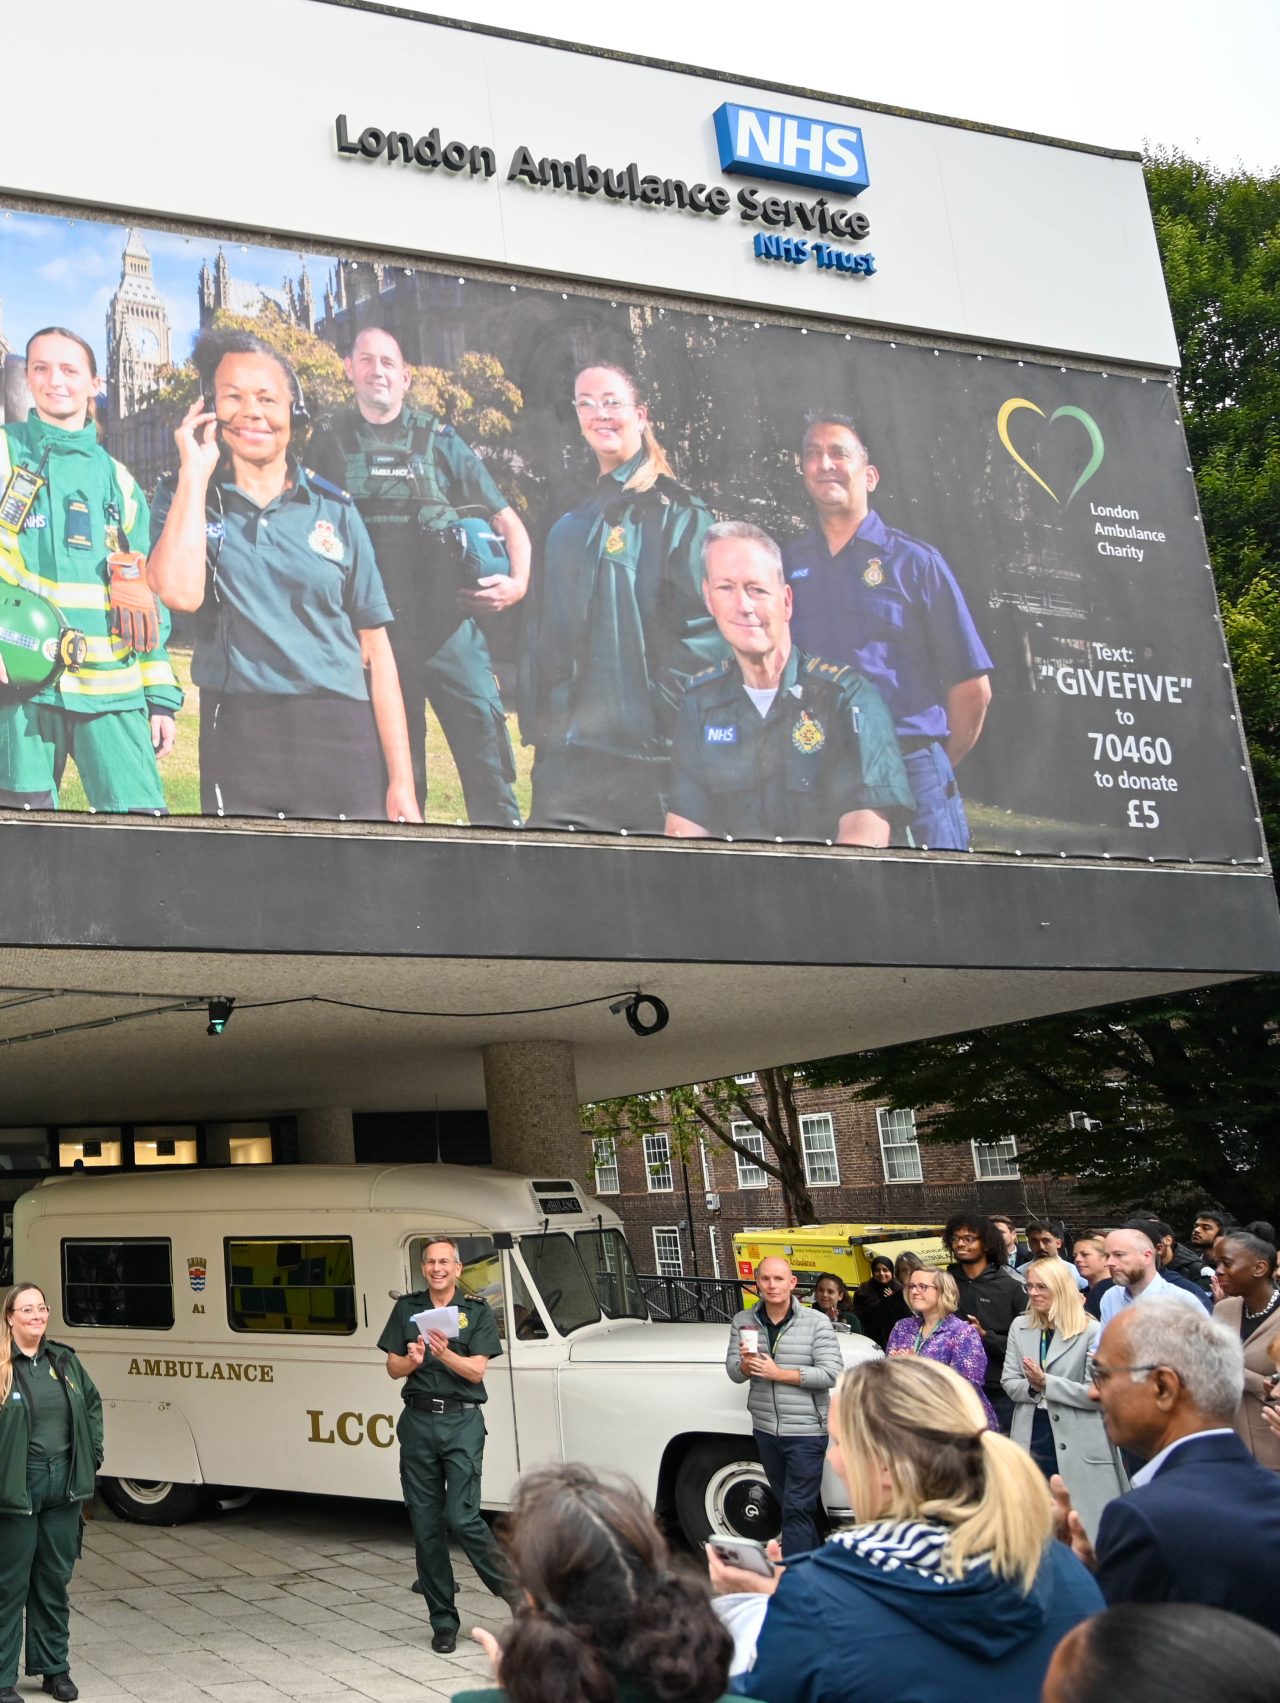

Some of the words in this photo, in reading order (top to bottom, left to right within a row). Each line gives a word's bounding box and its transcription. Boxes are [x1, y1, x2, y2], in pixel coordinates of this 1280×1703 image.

[736, 109, 859, 178] NHS
[336, 114, 496, 177] London
[507, 145, 730, 217] Ambulance
[738, 185, 871, 240] Service
[754, 231, 812, 264] NHS
[814, 242, 876, 276] Trust
[1090, 503, 1139, 520] London
[1094, 523, 1166, 542] Ambulance
[1097, 542, 1144, 562] Charity
[1092, 642, 1134, 663] Text:
[1040, 665, 1193, 704] "GIVEFIVE"
[1115, 708, 1134, 725] to
[708, 727, 733, 741] NHS
[1088, 732, 1172, 766] 70460
[1094, 771, 1113, 787] to
[1118, 770, 1178, 792] donate
[1127, 799, 1160, 829] £5
[192, 1303, 206, 1314] A1
[128, 1358, 274, 1383] AMBULANCE
[306, 1409, 395, 1449] LCC
